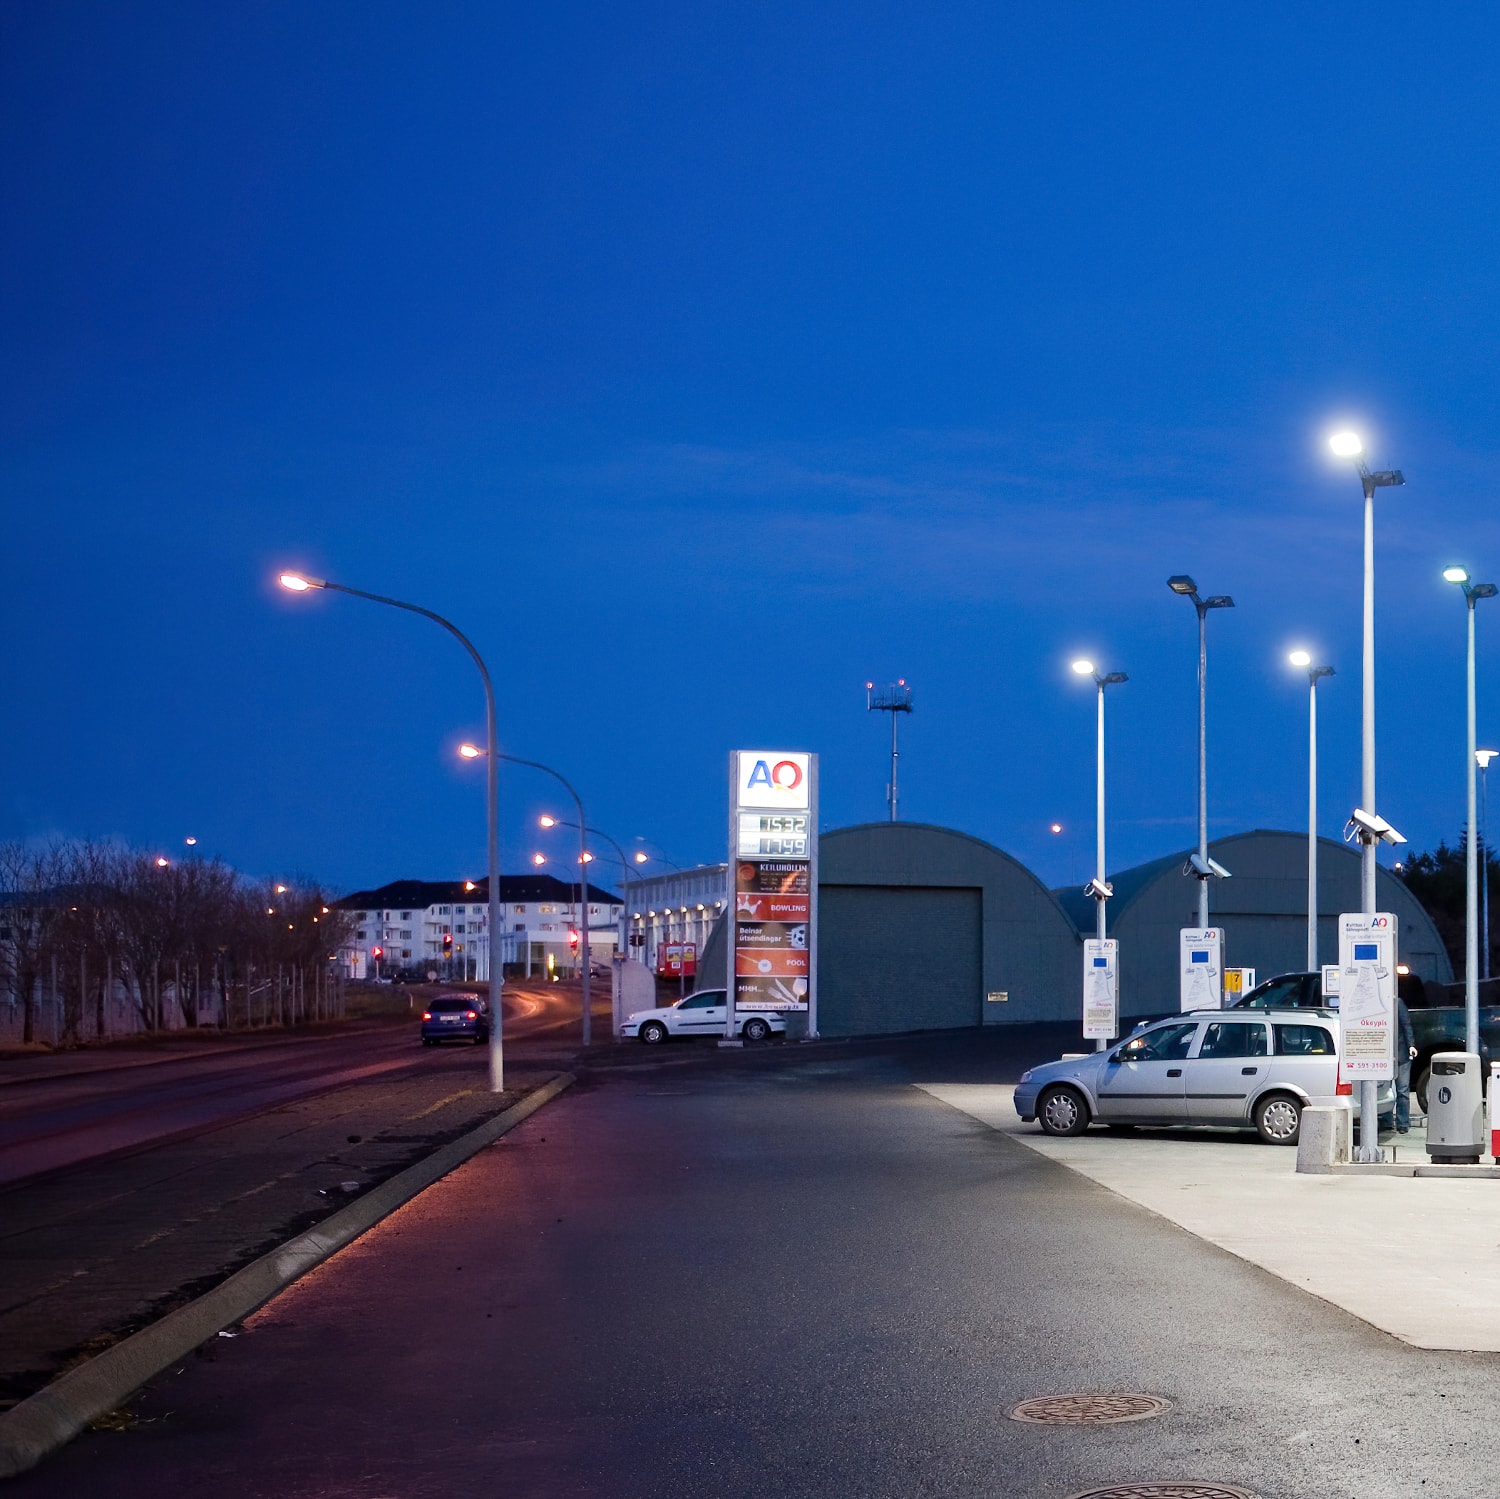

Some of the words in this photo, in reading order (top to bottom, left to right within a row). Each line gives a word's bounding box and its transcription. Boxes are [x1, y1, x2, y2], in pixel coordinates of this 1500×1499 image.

[770, 904, 807, 912] BOWLING
[739, 935, 782, 943] útsendingar
[1234, 974, 1240, 982] 7
